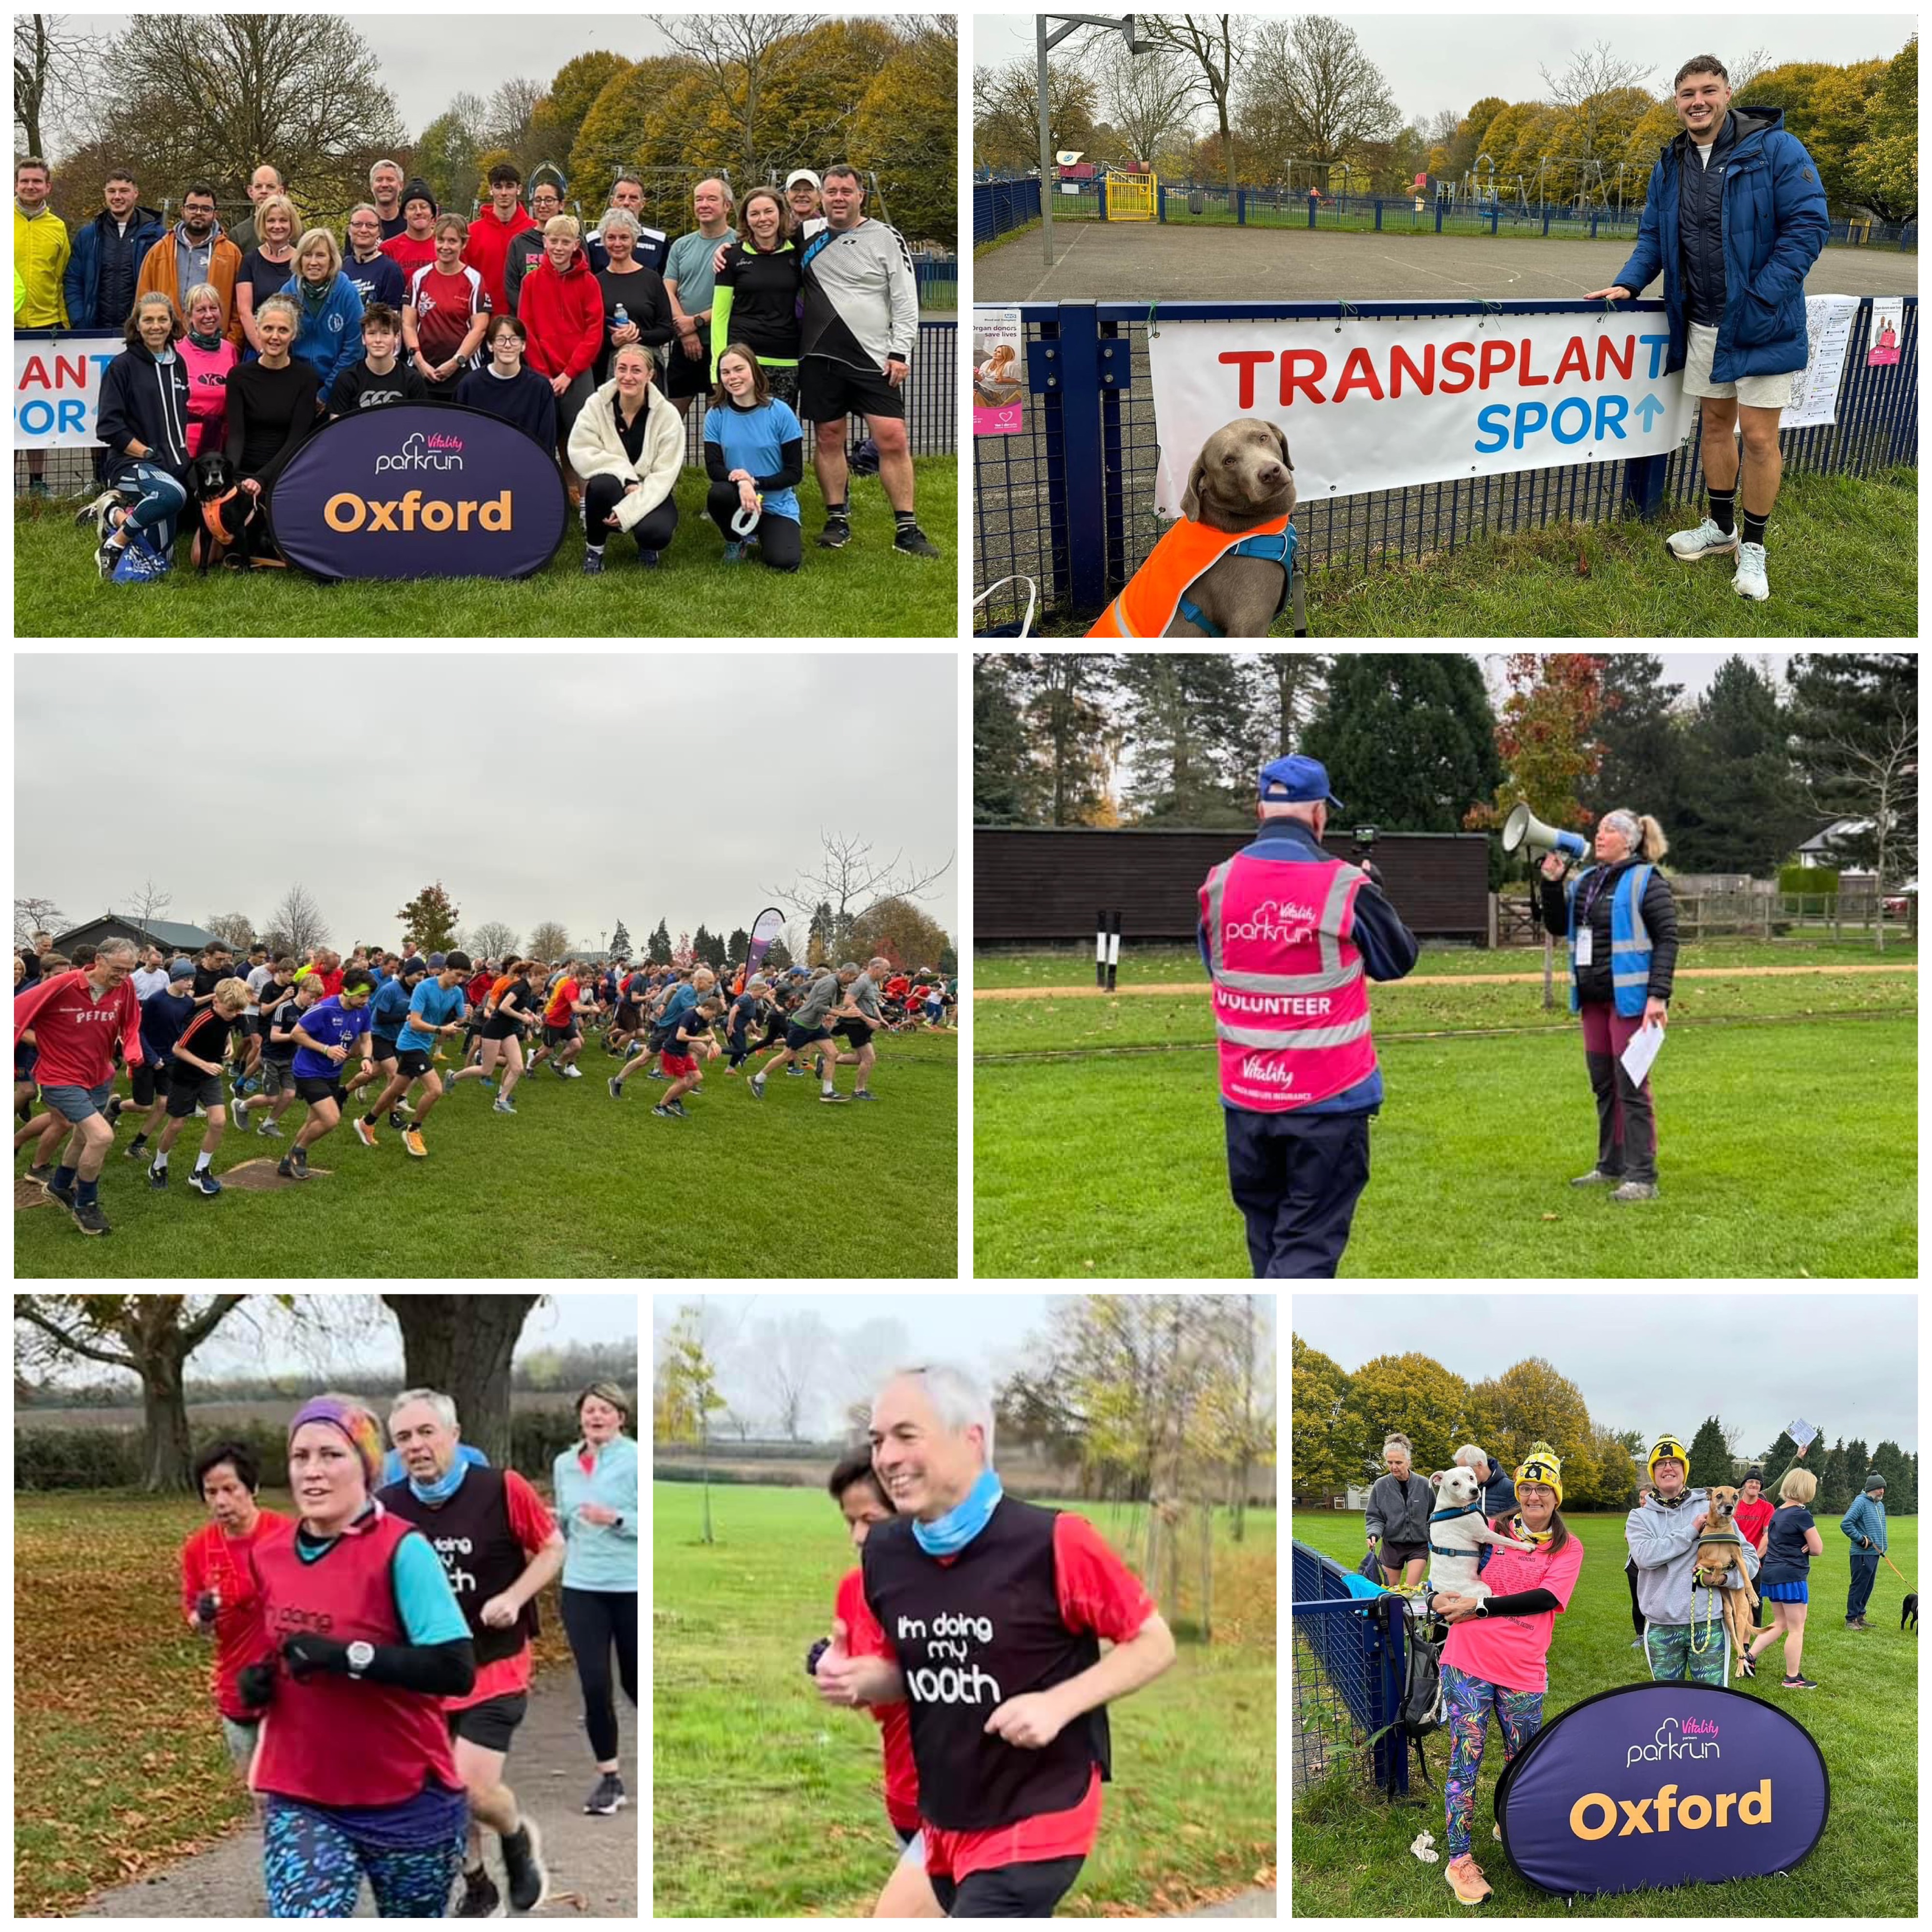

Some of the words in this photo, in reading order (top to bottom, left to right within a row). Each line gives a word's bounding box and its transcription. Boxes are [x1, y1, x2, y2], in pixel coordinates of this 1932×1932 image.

[1218, 334, 1669, 410] TRANSPLANT
[14, 399, 86, 435] OR
[427, 432, 463, 452] Vitality
[374, 444, 463, 475] parkrun
[323, 490, 512, 532] Oxford
[1226, 913, 1312, 944] parkrun
[1280, 902, 1316, 924] Vitality
[1217, 989, 1331, 1015] VOLUNTEER
[1243, 1054, 1294, 1091] Vitality
[932, 1611, 993, 1643] doing
[927, 1640, 967, 1662] my
[907, 1664, 1001, 1703] 100th
[1681, 1716, 1719, 1739] Vitality
[1626, 1732, 1720, 1768] parkrun
[1569, 1778, 1772, 1841] Oxford
